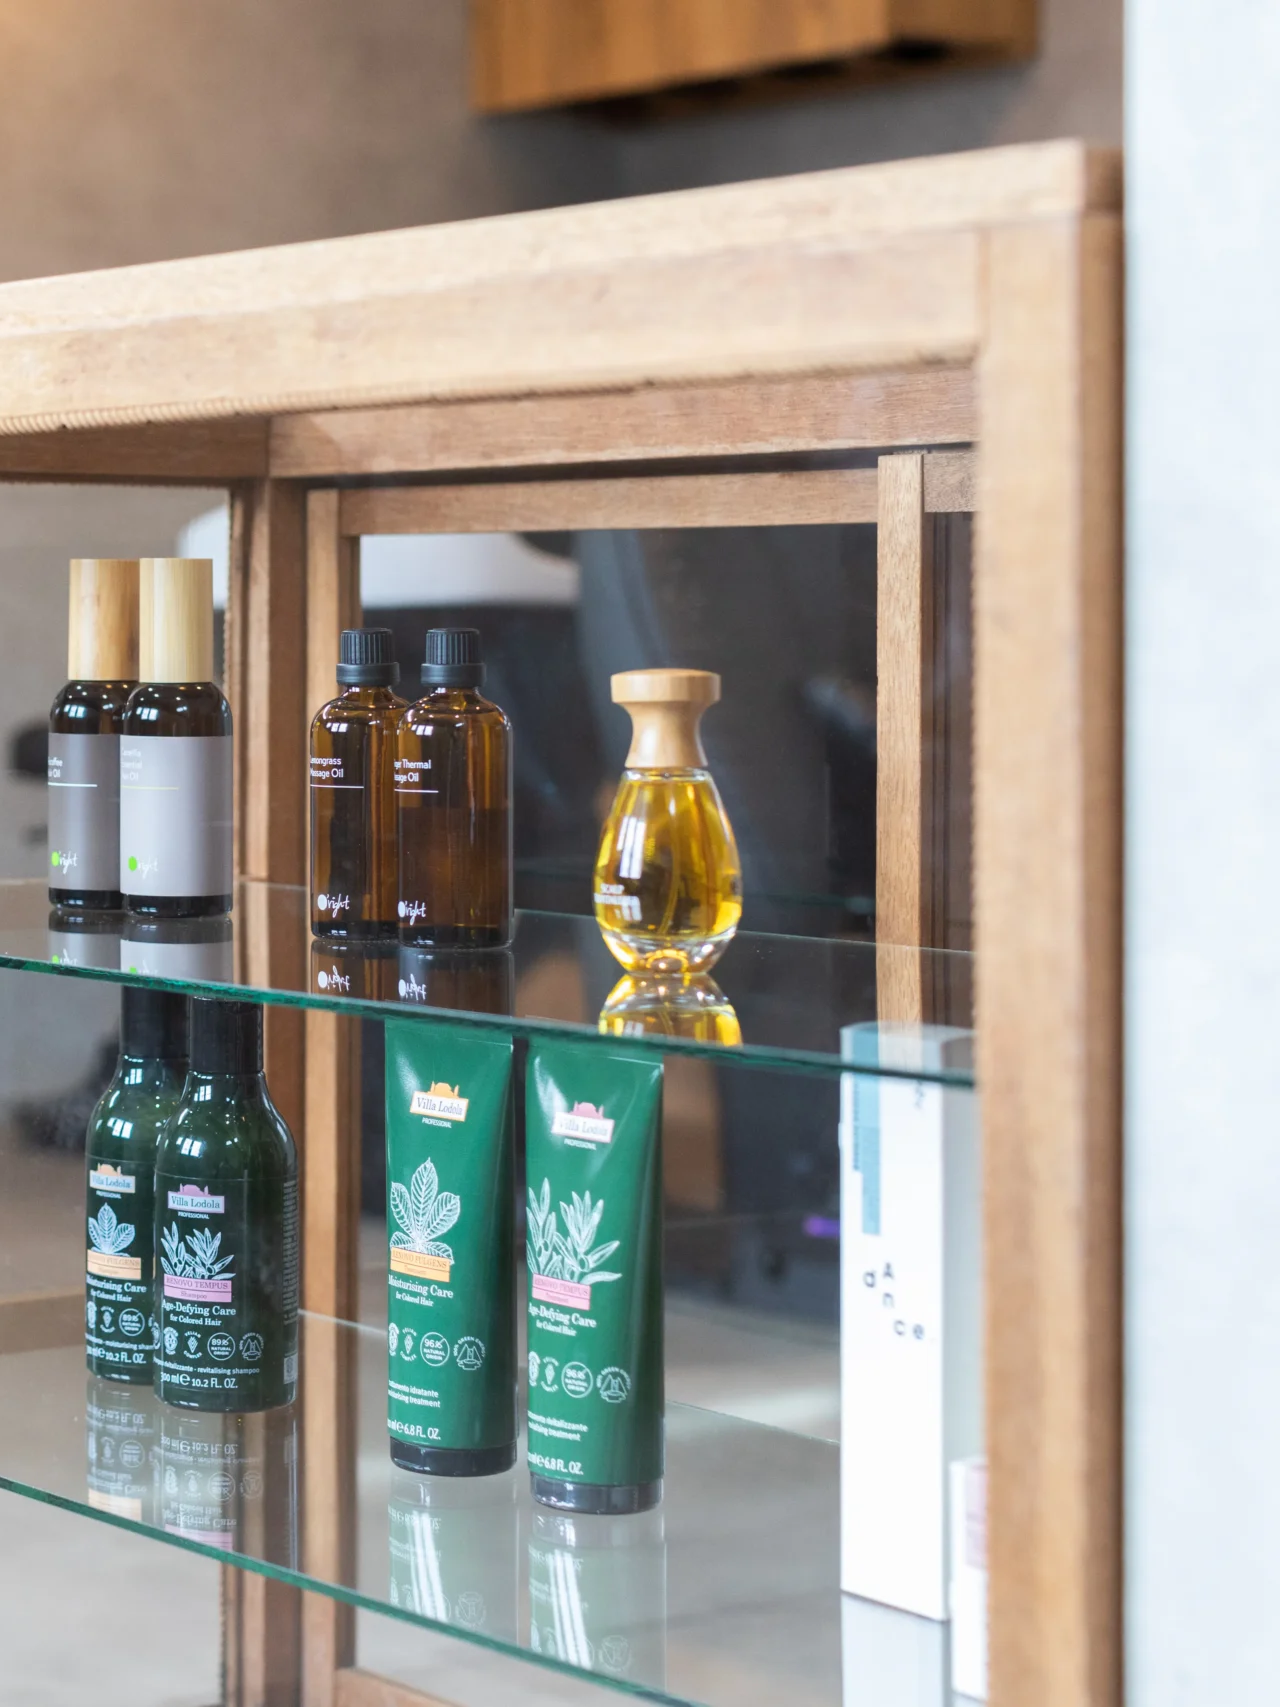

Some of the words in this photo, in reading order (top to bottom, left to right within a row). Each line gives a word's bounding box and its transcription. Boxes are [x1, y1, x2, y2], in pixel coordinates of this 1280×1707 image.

[402, 759, 431, 769] Thermal
[331, 768, 344, 778] Oil
[408, 772, 419, 783] Oil
[417, 1097, 436, 1111] Villa
[105, 1176, 132, 1189] Lodola
[171, 1196, 188, 1207] Villa
[191, 1198, 220, 1209] Lodola
[178, 1211, 210, 1219] PROFESSIONAL
[124, 1282, 147, 1293] Care
[194, 1281, 228, 1290] TEMPUS
[430, 1284, 454, 1299] Care
[117, 1294, 132, 1302] Hair
[181, 1291, 207, 1300] Shampoo
[161, 1299, 210, 1316] Age-Defying
[212, 1305, 236, 1315] Care
[420, 1297, 434, 1307] Hair
[170, 1313, 178, 1321] for
[179, 1315, 203, 1325] Colored
[571, 1312, 597, 1328] Care
[121, 1352, 132, 1363] FL.
[133, 1353, 147, 1364] OZ.
[423, 1348, 446, 1357] NATURAL
[197, 1367, 231, 1376] revitalising
[232, 1367, 260, 1375] shampoo
[192, 1378, 209, 1387] 10.2
[210, 1377, 222, 1388] FL.
[223, 1378, 238, 1389] OZ.
[410, 1385, 439, 1398] idratante
[409, 1396, 441, 1408] treatment
[404, 1423, 415, 1436] 6.8
[416, 1425, 427, 1438] FL.
[427, 1427, 441, 1440] OZ.
[557, 1458, 568, 1473] FL.
[568, 1461, 584, 1475] OZ.
